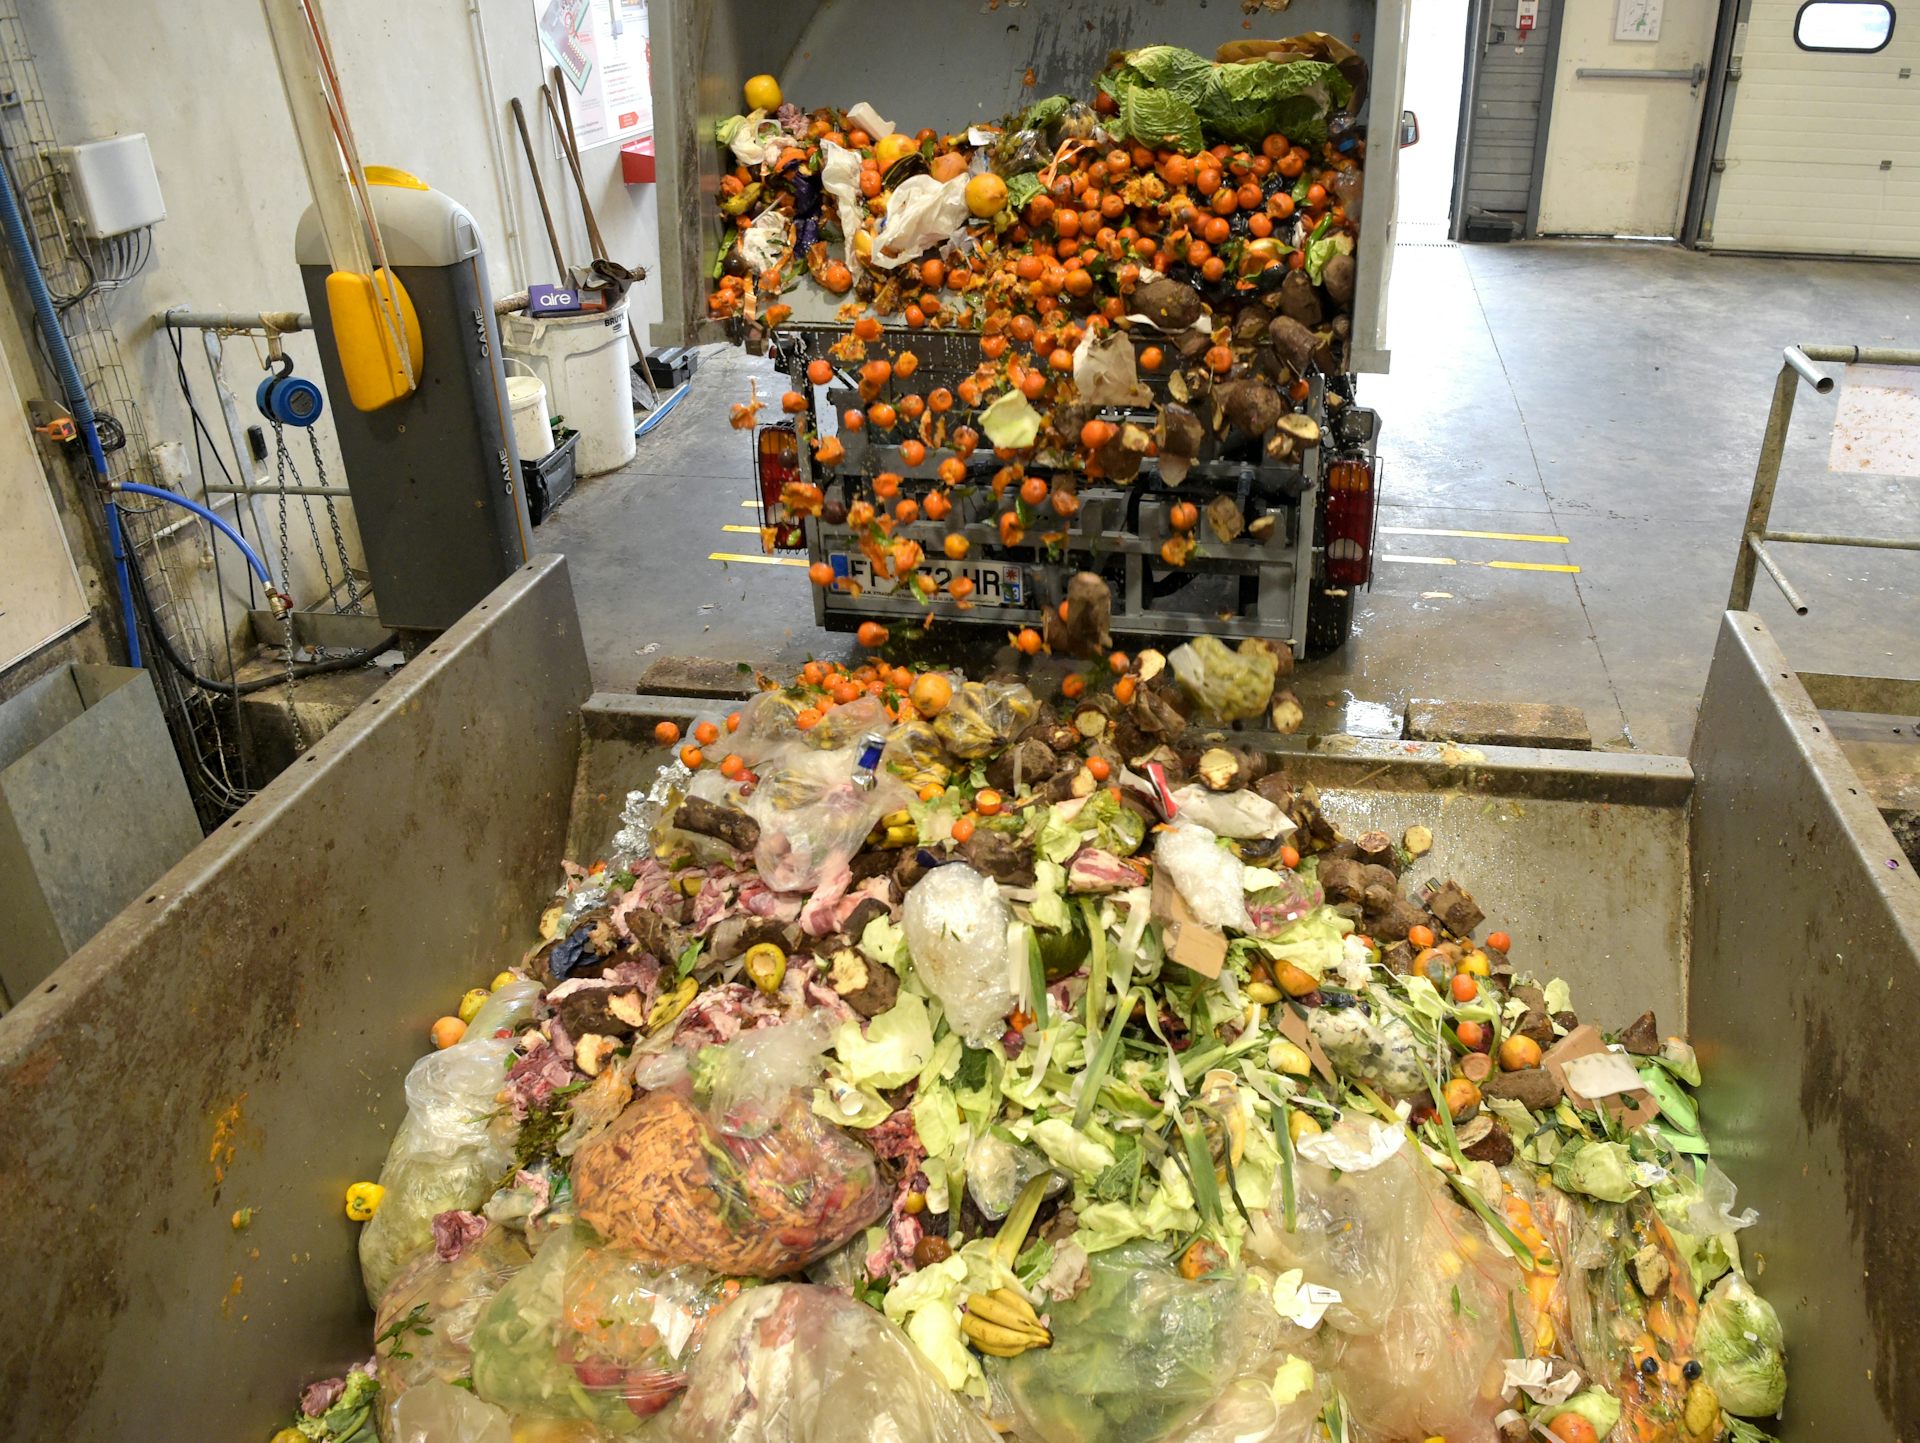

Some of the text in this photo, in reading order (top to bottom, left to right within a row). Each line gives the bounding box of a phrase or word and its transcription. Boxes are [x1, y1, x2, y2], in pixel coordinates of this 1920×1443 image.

[540, 293, 571, 306] aire
[474, 307, 490, 358] CAME
[499, 447, 513, 495] CAME
